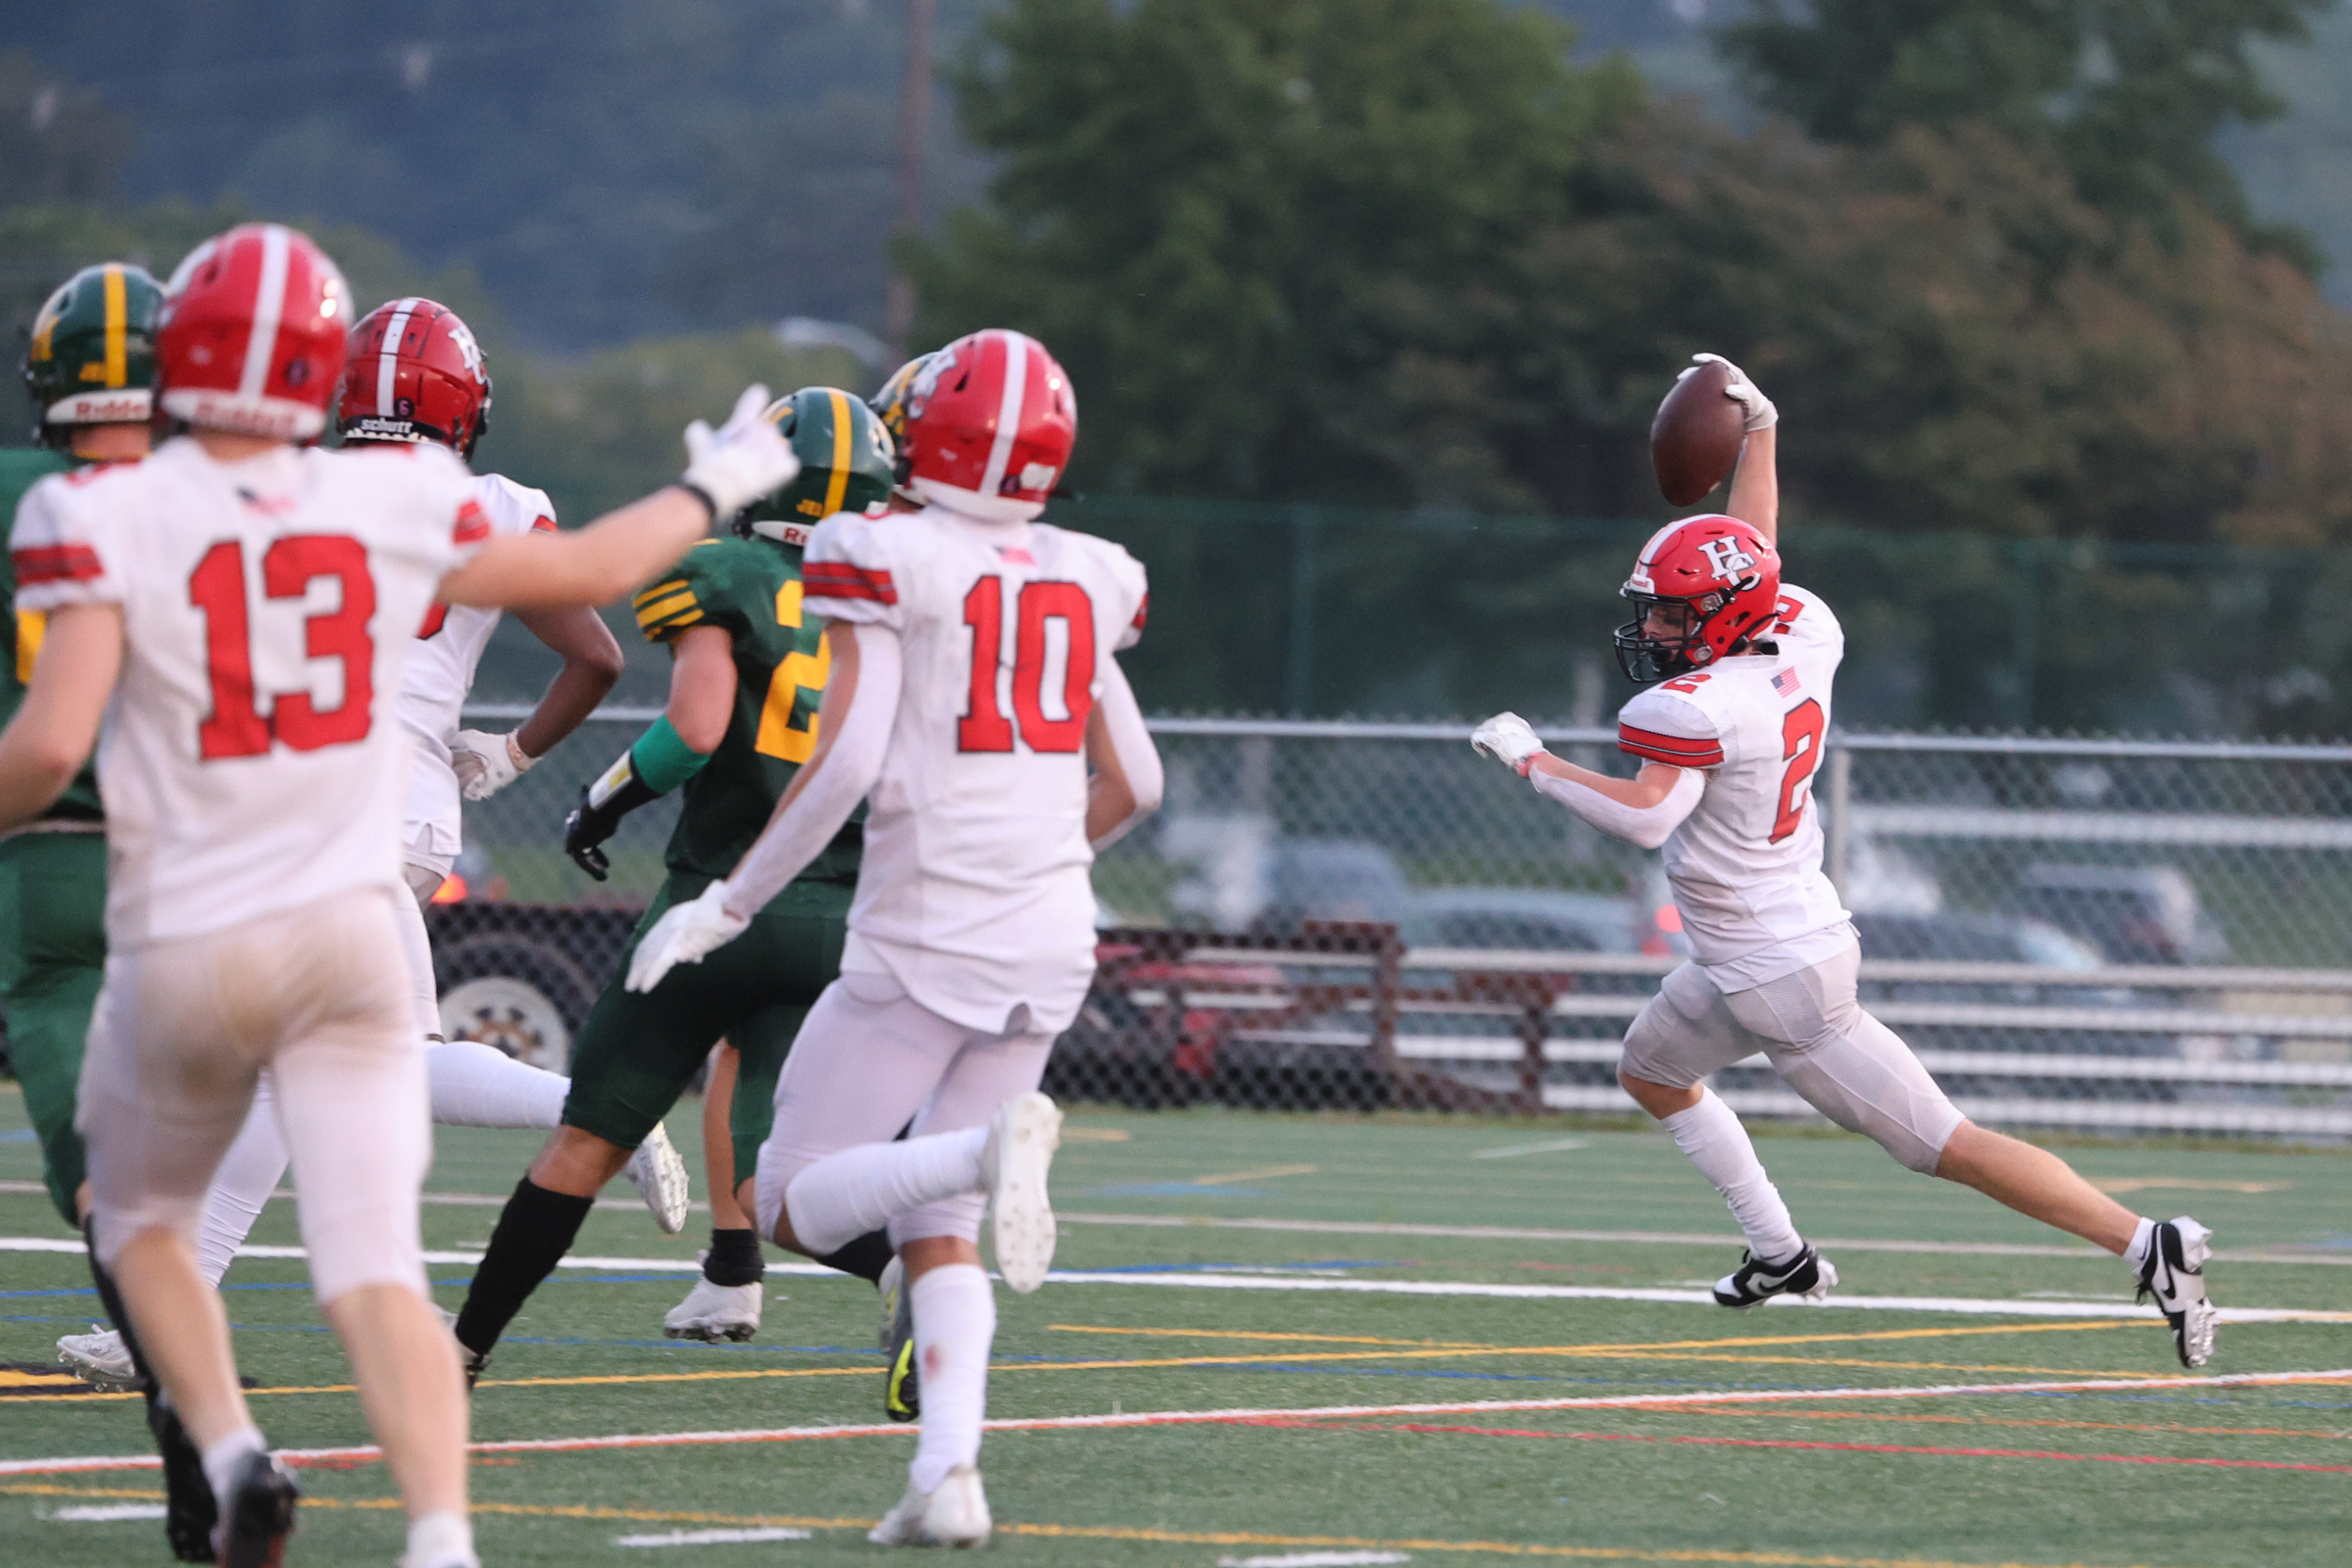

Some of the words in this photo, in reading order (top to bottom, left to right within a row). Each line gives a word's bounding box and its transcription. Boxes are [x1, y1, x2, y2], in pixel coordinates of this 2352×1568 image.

[188, 534, 376, 760] 13
[956, 573, 1096, 753] 10
[1767, 696, 1825, 846] 2
